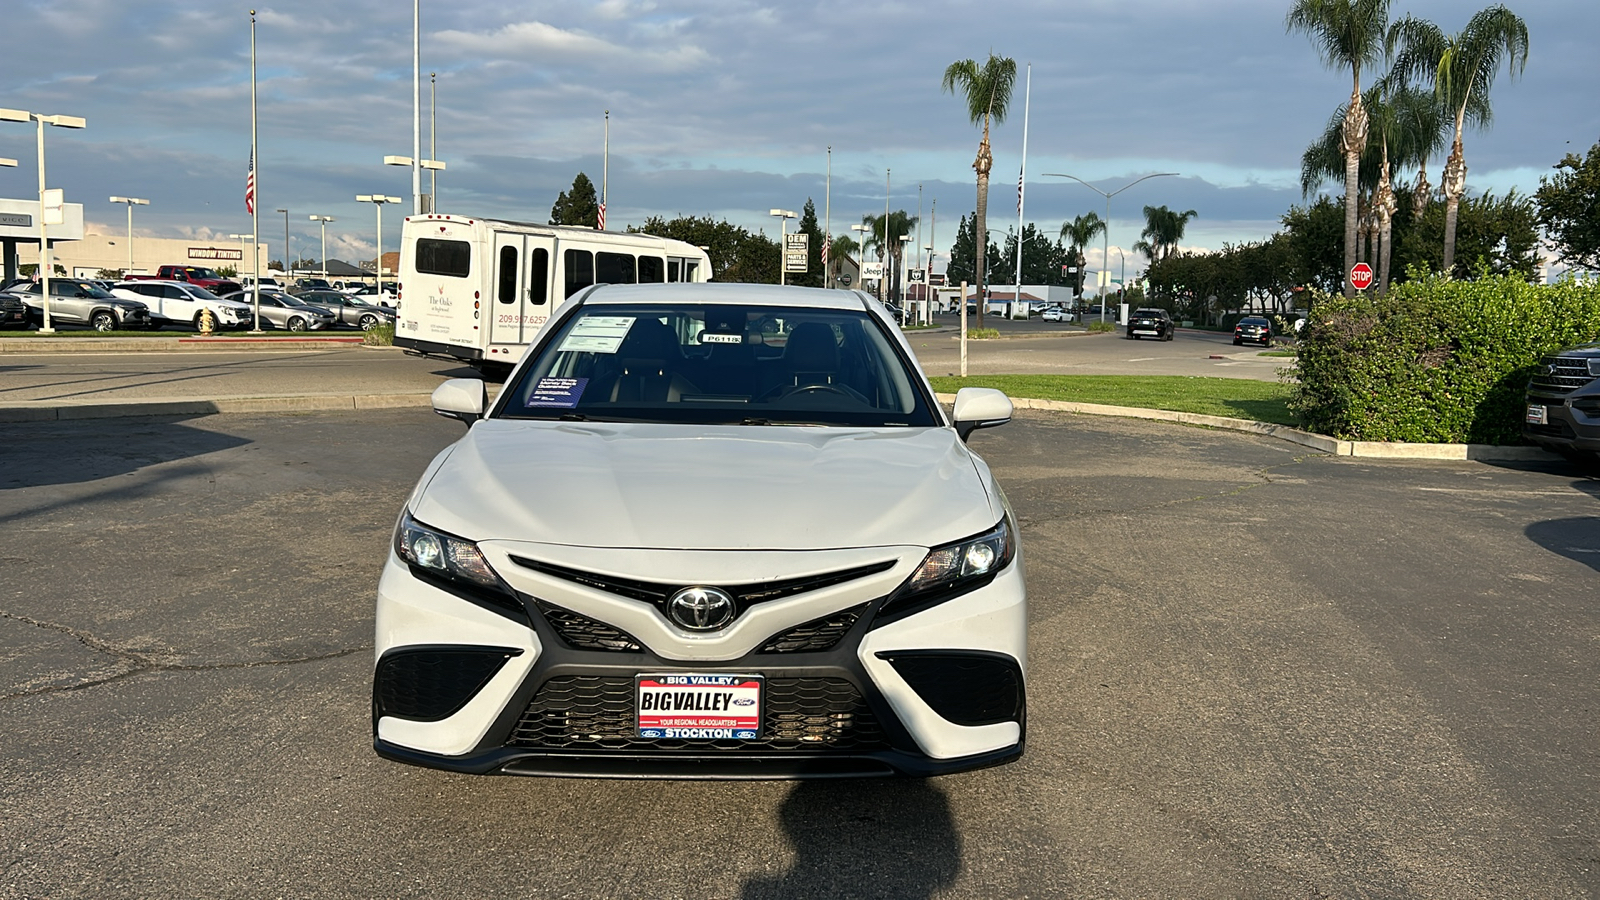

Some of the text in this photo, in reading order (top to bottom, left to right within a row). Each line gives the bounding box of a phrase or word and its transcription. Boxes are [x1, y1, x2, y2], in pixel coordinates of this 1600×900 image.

[788, 235, 807, 243] OEM
[189, 249, 241, 259] WINDOW TINTING
[863, 267, 882, 276] Jeep
[1352, 271, 1371, 281] STOP
[428, 295, 453, 306] The Oaks
[667, 676, 733, 685] BIG VALLEY
[734, 698, 754, 706] Ford
[698, 719, 737, 727] HEADQUARTERS
[665, 728, 733, 738] STOCKTON
